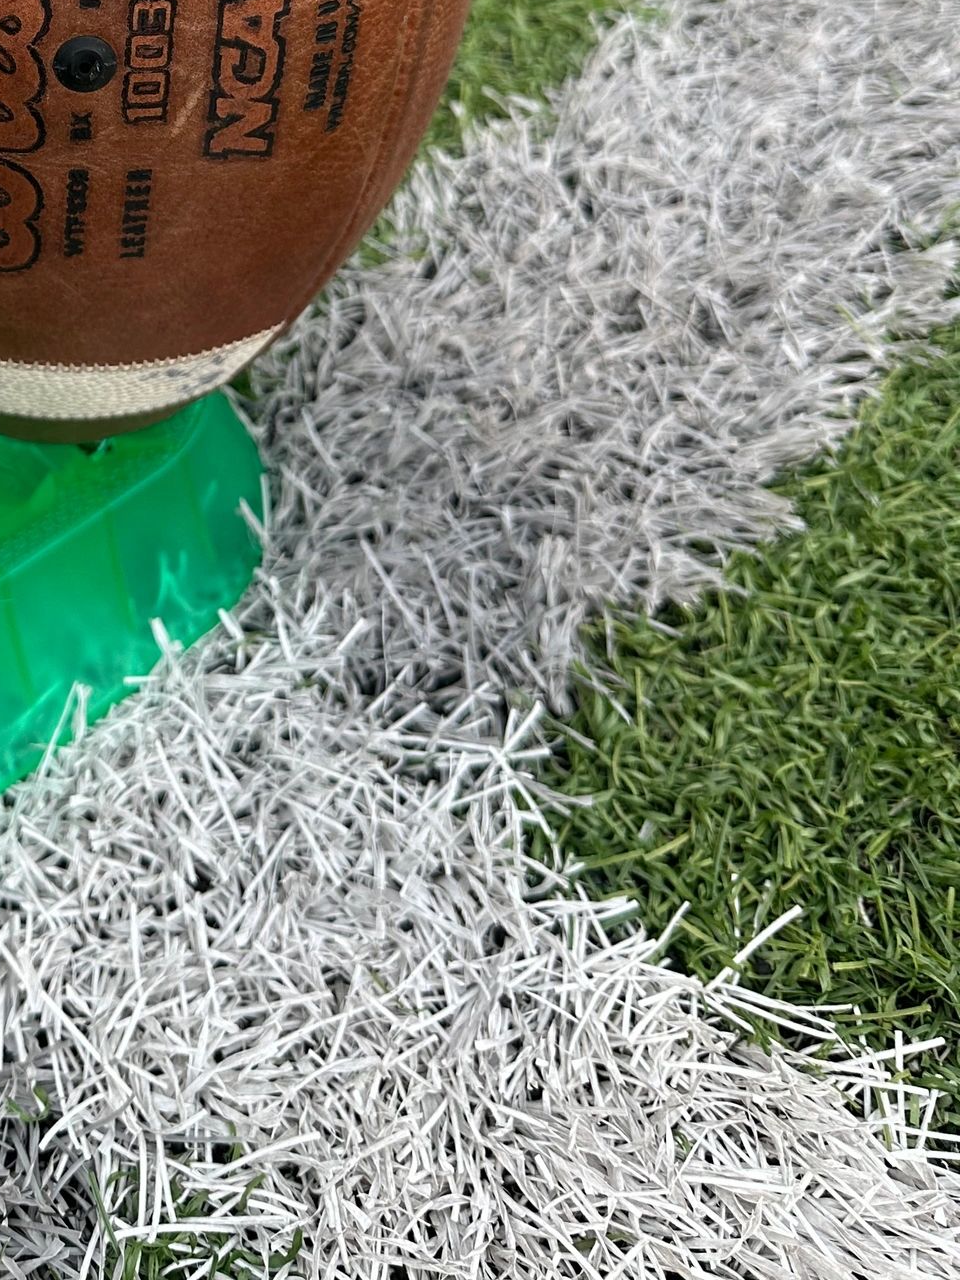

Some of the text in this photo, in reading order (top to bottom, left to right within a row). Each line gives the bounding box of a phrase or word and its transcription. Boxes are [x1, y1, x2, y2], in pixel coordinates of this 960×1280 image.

[316, 21, 338, 45] IN
[303, 50, 334, 112] MADE
[120, 168, 153, 258] LEATHER
